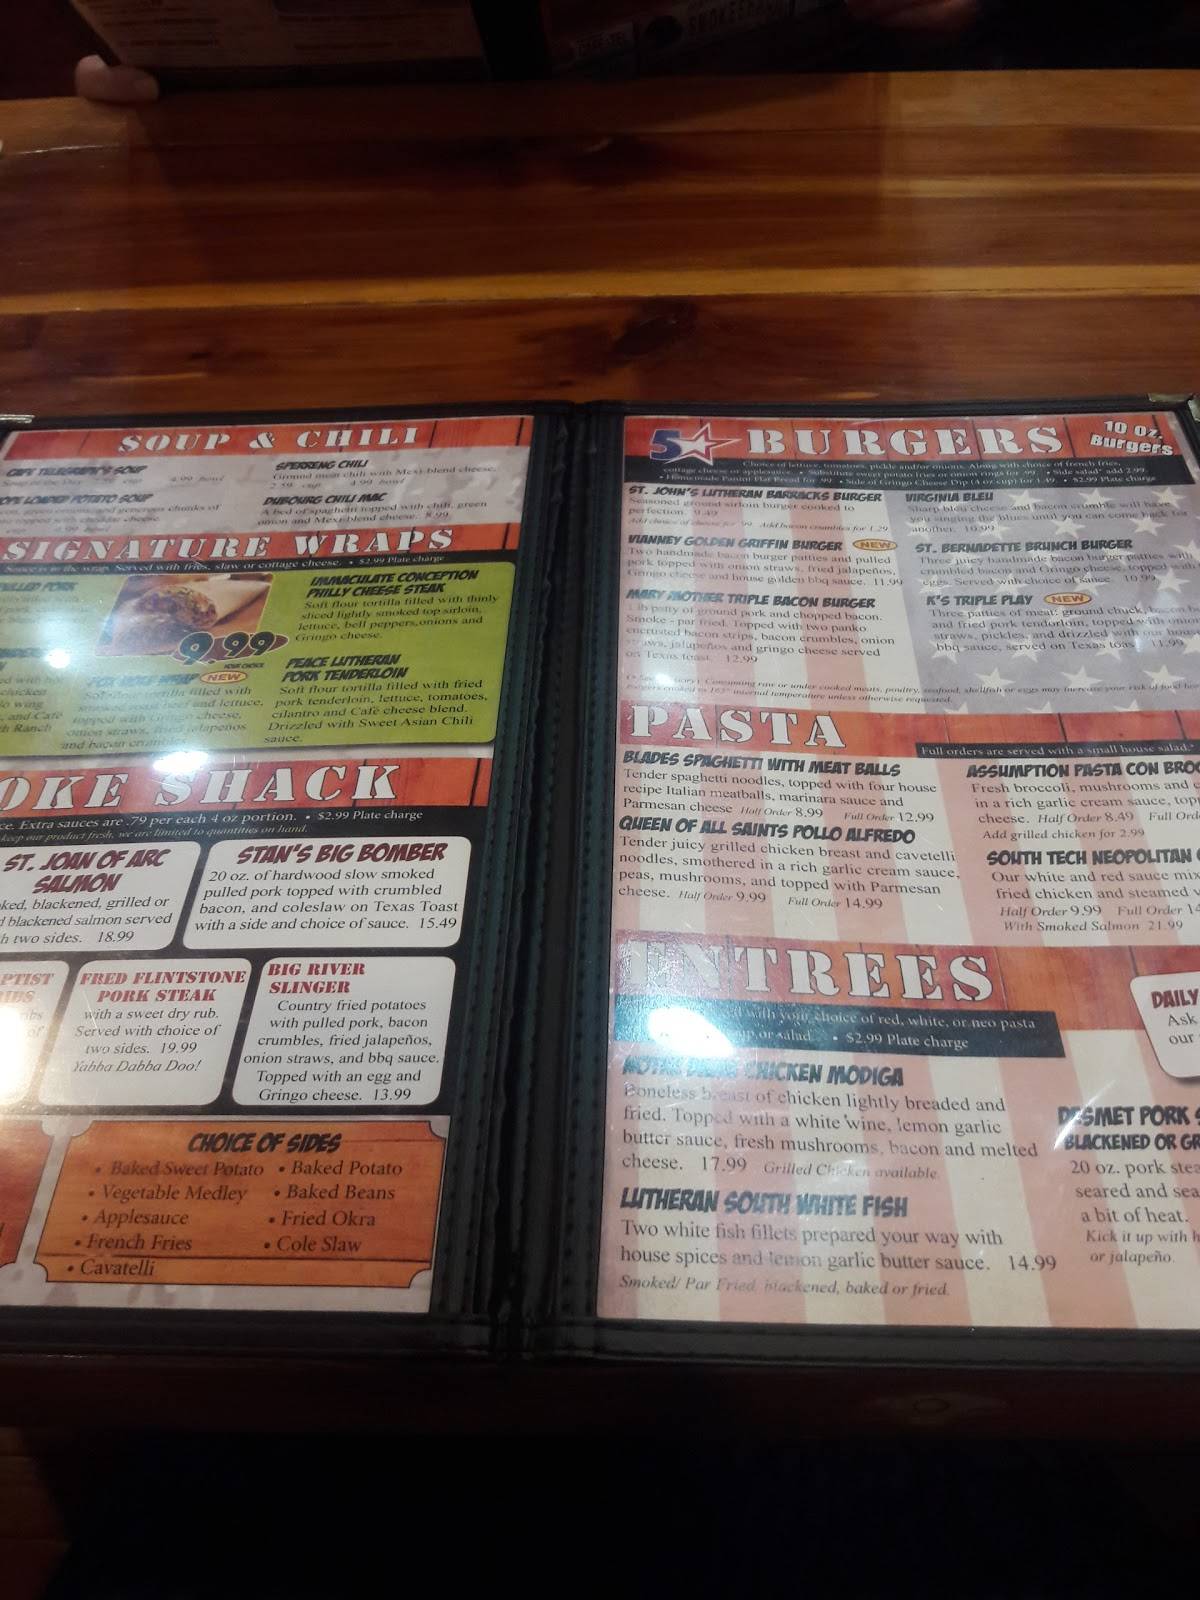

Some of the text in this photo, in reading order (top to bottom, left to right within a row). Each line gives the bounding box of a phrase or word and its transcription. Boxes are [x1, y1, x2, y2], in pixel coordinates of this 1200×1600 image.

[1104, 420, 1126, 434] 10
[118, 427, 418, 453] SOUP & CHILI
[650, 430, 682, 460] 5
[746, 426, 1063, 456] BURGERS
[1090, 433, 1173, 456] Burgers
[628, 486, 648, 495] ST.
[702, 488, 763, 498] LUTHERAN
[766, 489, 830, 500] BARRACKS
[833, 492, 882, 502] BURGER
[905, 492, 994, 502] VIRGINIA BLEU
[2, 528, 453, 561] SIGNATURE WRAPS
[628, 534, 892, 551] VIANNEY GOLDEN GRIFFIN BURGER NEW
[915, 538, 1133, 554] ST. BERNADETTE BRUNCH BURGER
[310, 569, 479, 586] IMMACULATE CONCEPTION
[306, 583, 446, 598] PHILLY CHEESE STEAK
[626, 588, 876, 609] MARY MOTHER TRIPLE BACON BURGER
[926, 594, 1084, 606] K'S TRIPLE PLAY NEW
[286, 654, 401, 668] PEACE LUTHERAN
[207, 672, 242, 681] NEW
[281, 667, 409, 683] PORK TENDERLOIN
[386, 680, 419, 690] filled
[422, 680, 450, 689] with
[453, 679, 483, 688] fried
[628, 704, 847, 748] PASTA
[623, 751, 901, 777] BLADES SPAGHETTI WITH MEAT BALLS
[966, 761, 1159, 778] ASSUMPTION PASTA CON
[154, 765, 399, 807] SHACK
[623, 769, 937, 793] Tender spaghetti noodles, topped with four house
[317, 810, 423, 822] $2.99 Plate charge
[795, 807, 824, 818] 8.99
[898, 811, 935, 823] 12.99
[619, 815, 916, 845] QUEEN OF ALL SAINTS POLLO ALFREDO
[3, 848, 172, 873] ST. JOAN OF ARC
[236, 842, 449, 865] STAN'S BIG BOMBER
[986, 848, 1192, 866] SOUTH TECH NEOPOLITAN
[208, 868, 435, 882] 20 oz. of hardwood slow smoked
[32, 873, 123, 895] SALMON
[203, 884, 442, 901] pulled pork topped with crumbled
[843, 897, 883, 910] 14.99
[194, 917, 457, 931] with a side and choice of sauce. 15.49
[97, 931, 135, 943] 18.99
[267, 962, 366, 976] BIG RIVER
[79, 970, 247, 985] FRED FLINTSTONE
[268, 981, 351, 994] SLINGER
[96, 989, 217, 1003] PORK STEAK
[1151, 989, 1199, 1008] DAILY
[277, 1000, 427, 1013] Country fried potatoes
[159, 1042, 198, 1054] 19.99
[744, 1061, 904, 1086] CHICKEN MODIGA
[258, 1088, 412, 1104] Gringo cheese. 13.99
[1140, 1106, 1188, 1126] PORK
[187, 1132, 343, 1153] CHOICE OF SIDES
[1064, 1134, 1178, 1150] BLACKENED OR
[110, 1161, 265, 1177] Baked Sweet Potato
[291, 1160, 403, 1175] Baked Potato
[701, 1156, 748, 1172] 17.99
[619, 1187, 908, 1218] LUTHERAN SOUTH WHITE FISH
[92, 1209, 189, 1229] Applesauce
[87, 1234, 193, 1250] French Fries
[80, 1259, 155, 1276] Cavatelli
[1007, 1254, 1057, 1271] 14.99
